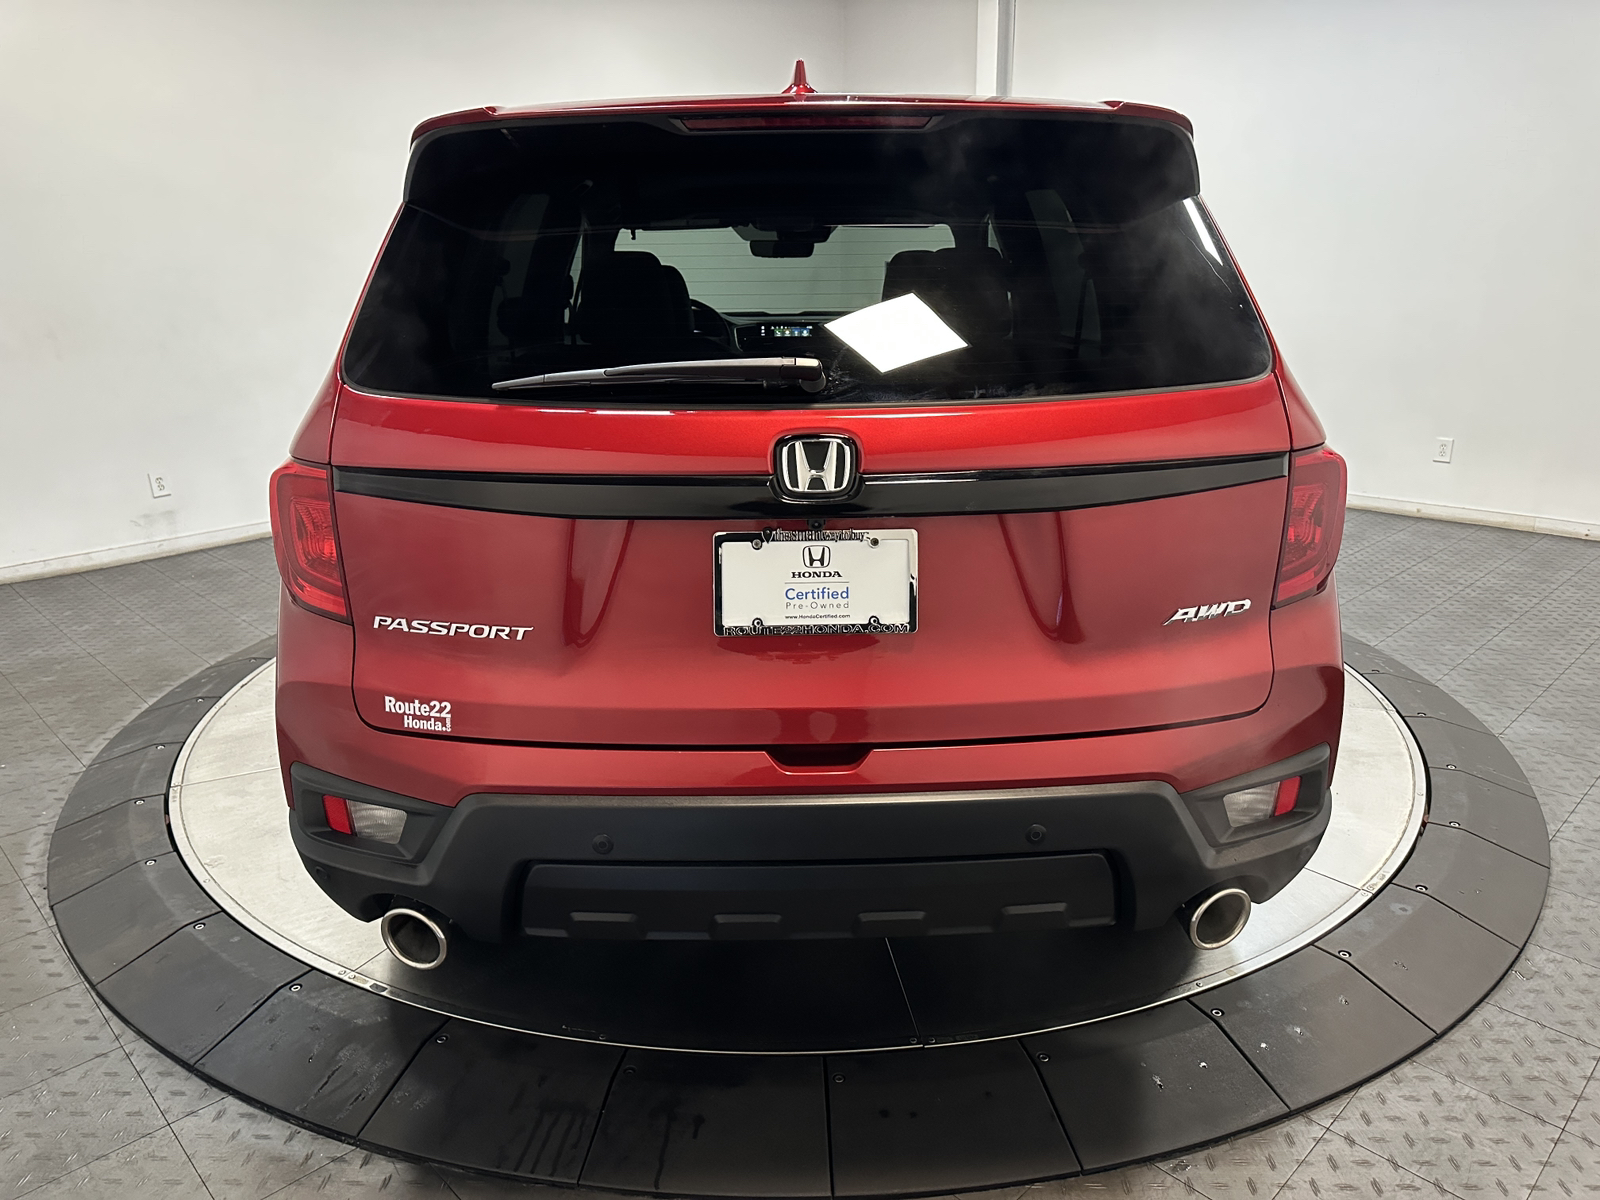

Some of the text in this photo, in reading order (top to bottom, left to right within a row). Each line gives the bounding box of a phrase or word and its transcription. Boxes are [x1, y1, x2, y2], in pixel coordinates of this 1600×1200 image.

[785, 586, 849, 600] Certified
[785, 601, 849, 609] Pre-Owned
[1162, 599, 1252, 626] AWD
[373, 615, 534, 640] PASSPORT
[384, 695, 451, 718] Route22
